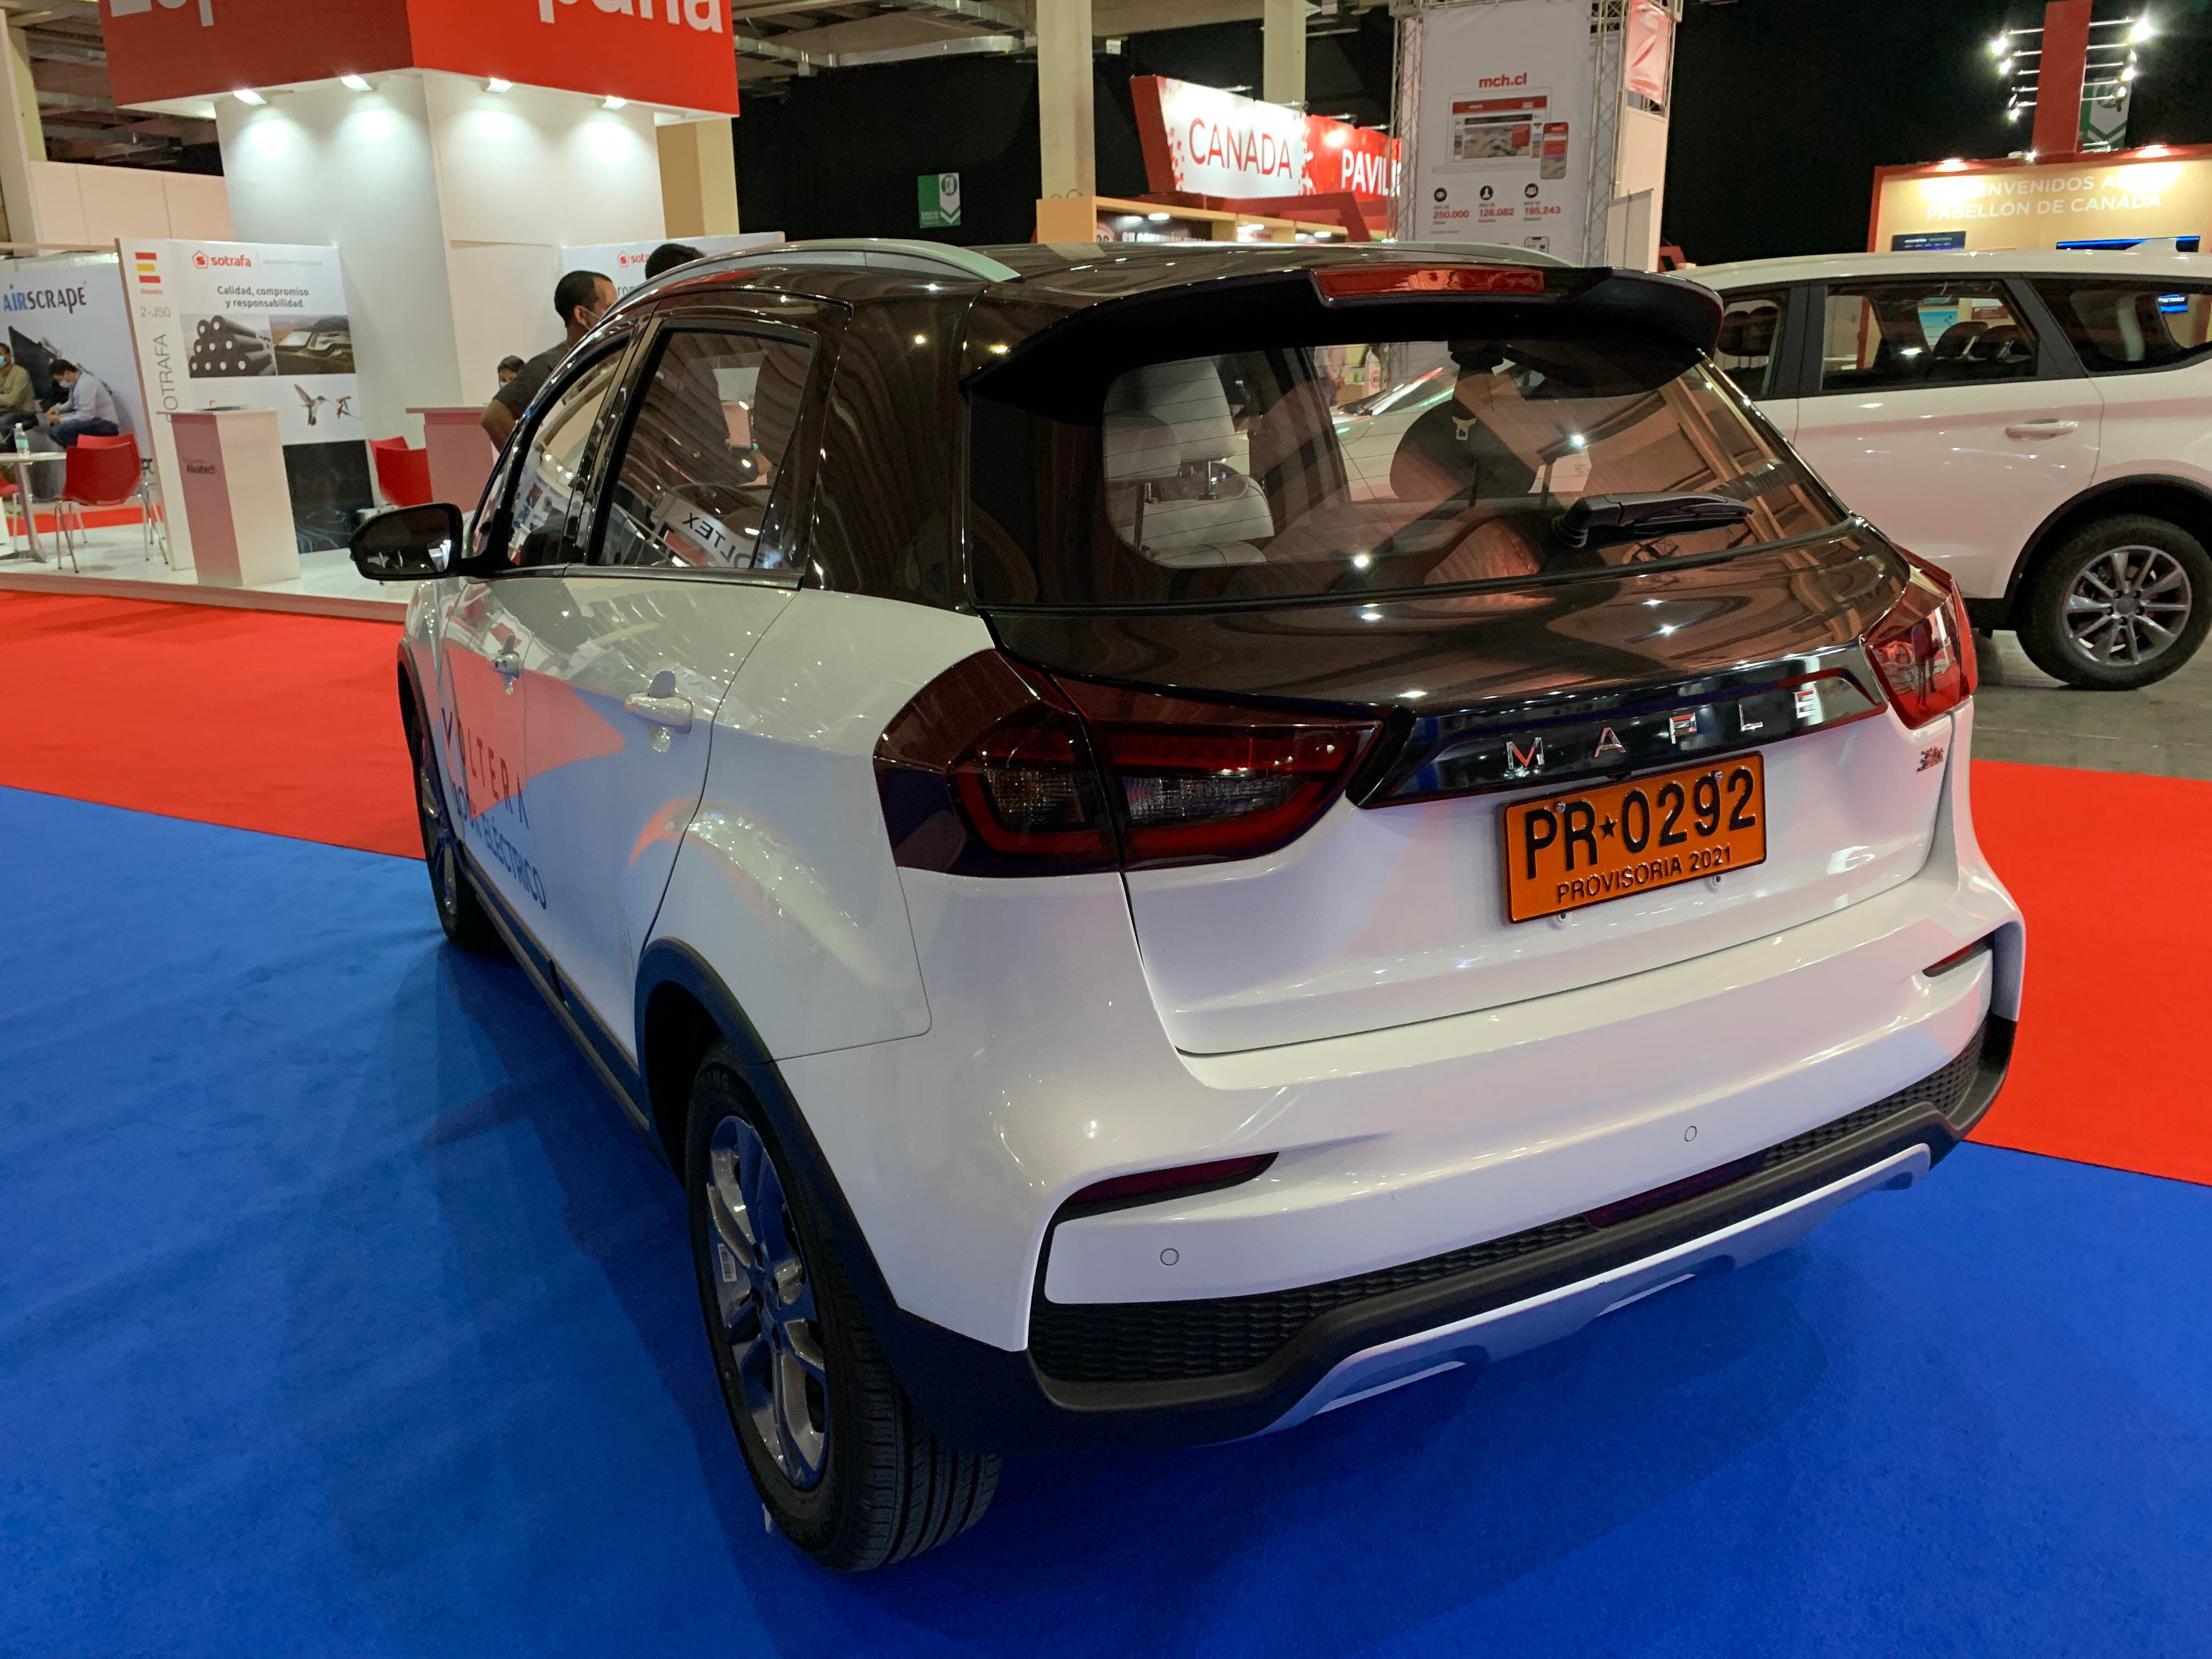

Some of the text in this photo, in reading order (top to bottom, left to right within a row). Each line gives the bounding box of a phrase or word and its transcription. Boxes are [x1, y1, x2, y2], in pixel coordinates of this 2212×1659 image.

[1479, 72, 1527, 88] mch.cl
[1189, 117, 1293, 179] CANADA
[1480, 207, 1515, 217] 126.082
[1524, 206, 1561, 215] 195.243
[2037, 199, 2065, 214] DE
[1432, 210, 1470, 219] 250.000
[211, 253, 252, 268] sotrafa
[217, 285, 309, 298] Calidad, compromiso
[224, 298, 306, 309] y responsabilidad.
[1505, 689, 1818, 770] MAPLE
[1557, 844, 1732, 904] PROVISORIA 2021
